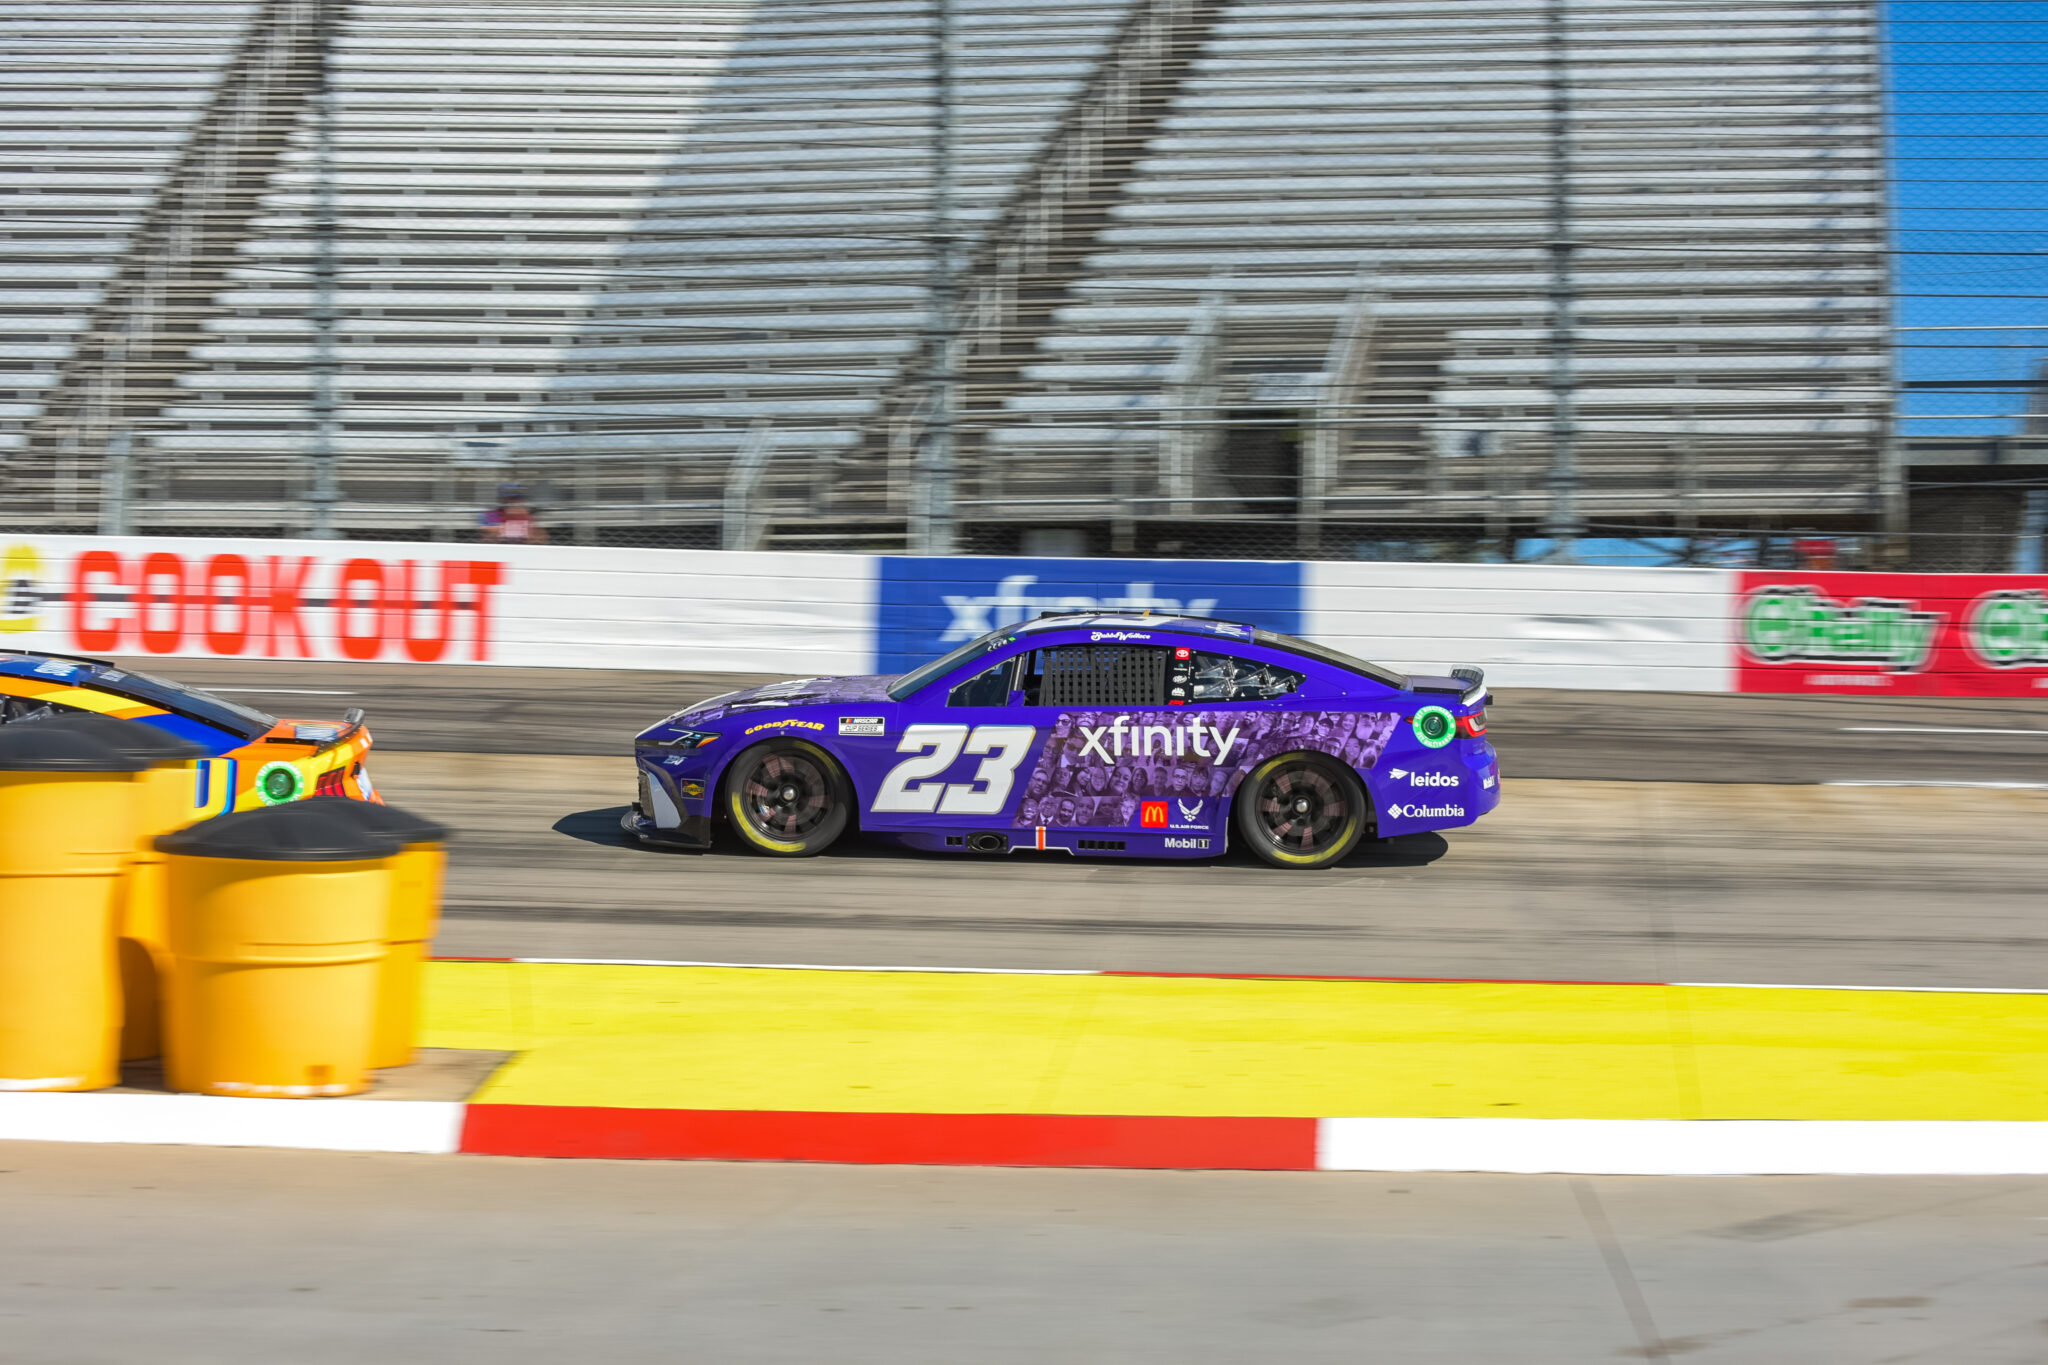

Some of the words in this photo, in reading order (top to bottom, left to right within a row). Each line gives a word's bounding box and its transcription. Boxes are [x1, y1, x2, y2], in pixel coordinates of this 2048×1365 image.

[744, 719, 825, 735] GOODYEAR
[1078, 715, 1240, 766] xfinity
[870, 722, 1037, 815] 23
[1410, 771, 1460, 787] leidos
[1402, 803, 1465, 818] Columbia
[1164, 837, 1197, 849] Mobil
